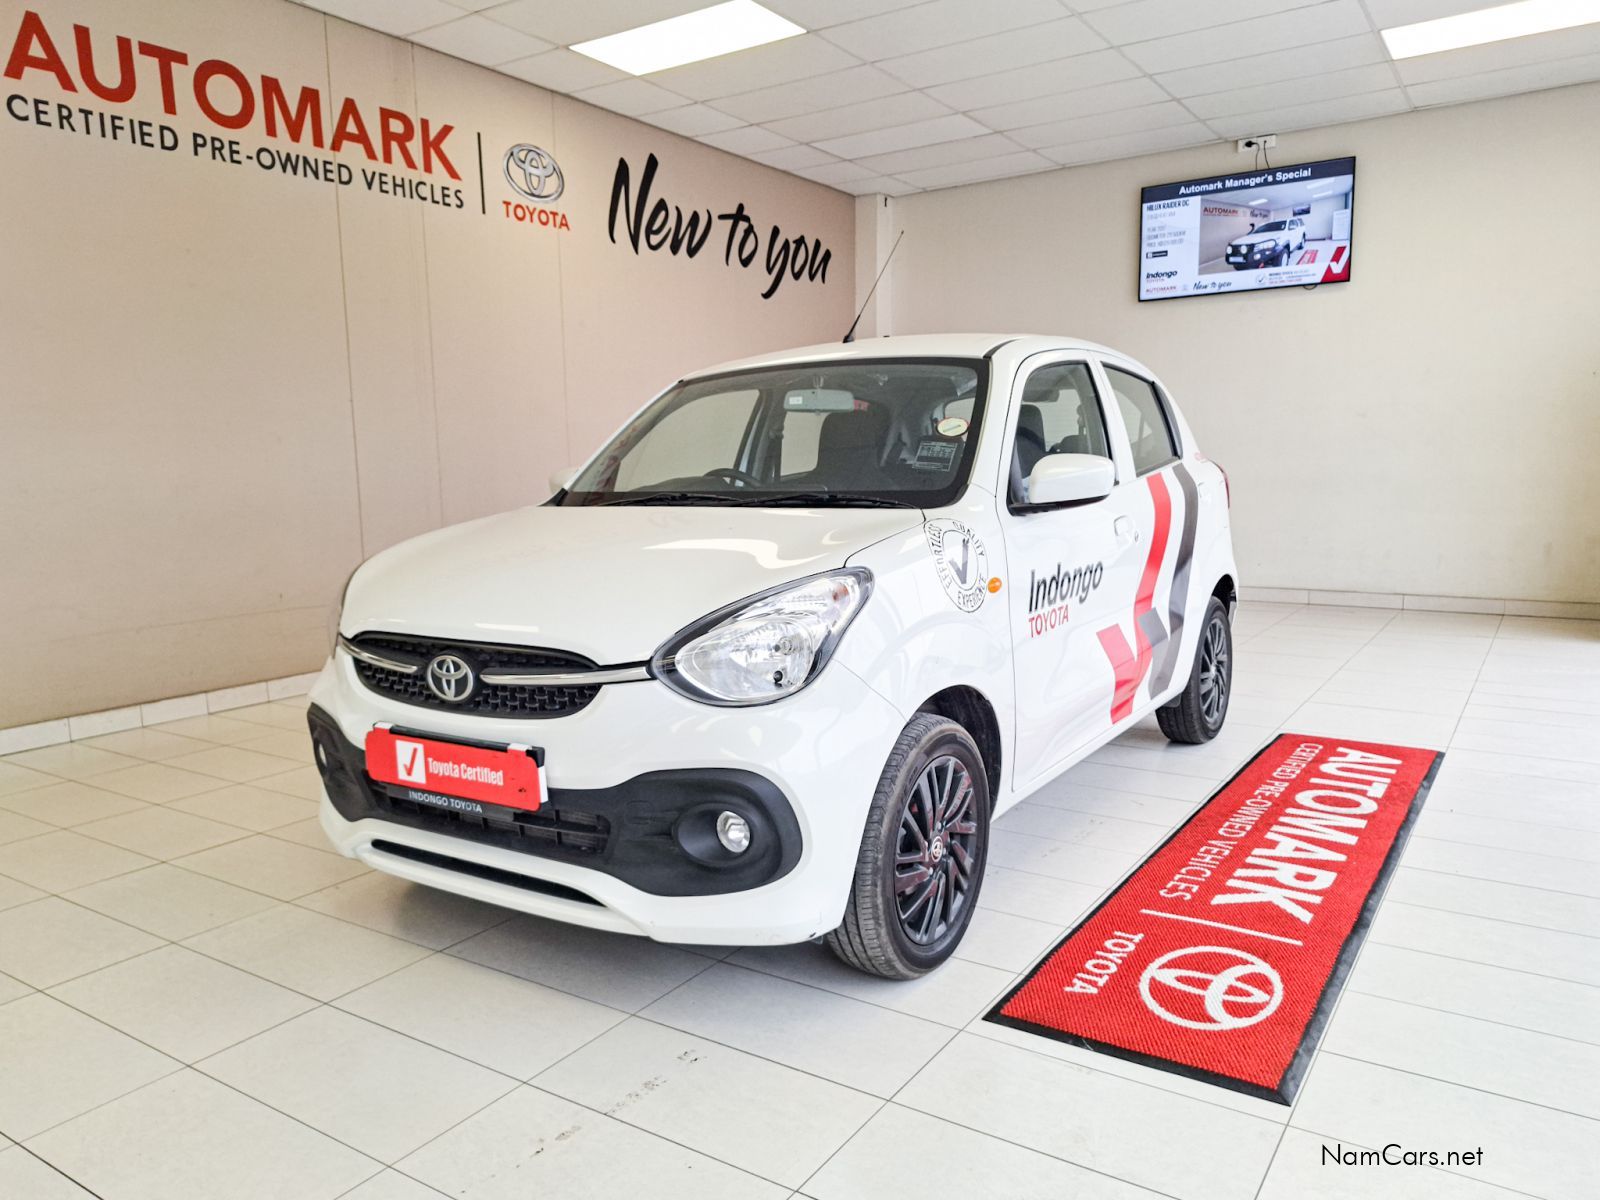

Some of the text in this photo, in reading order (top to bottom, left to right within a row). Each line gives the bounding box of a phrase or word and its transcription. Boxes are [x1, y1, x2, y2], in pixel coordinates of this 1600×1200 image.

[4, 10, 462, 181] AUTOMARK
[7, 94, 464, 209] CERTIFIED PRE-OWNED VEHICLES
[1179, 168, 1312, 195] Automark Manager's Special
[502, 200, 570, 231] TOYOTA
[608, 153, 832, 299] New to you
[1146, 270, 1178, 279] Indongo
[1193, 281, 1208, 290] New
[1029, 561, 1103, 613] Indongo
[1029, 604, 1069, 638] TOYOTA
[428, 758, 504, 785] Toyota Certified
[409, 790, 482, 813] INDONGO TOYOTA
[1159, 743, 1323, 900] CERTIFIED PRE-OWNED VEHICLES
[1210, 747, 1402, 924] AUTOMARK
[1064, 931, 1145, 994] TOYOTA
